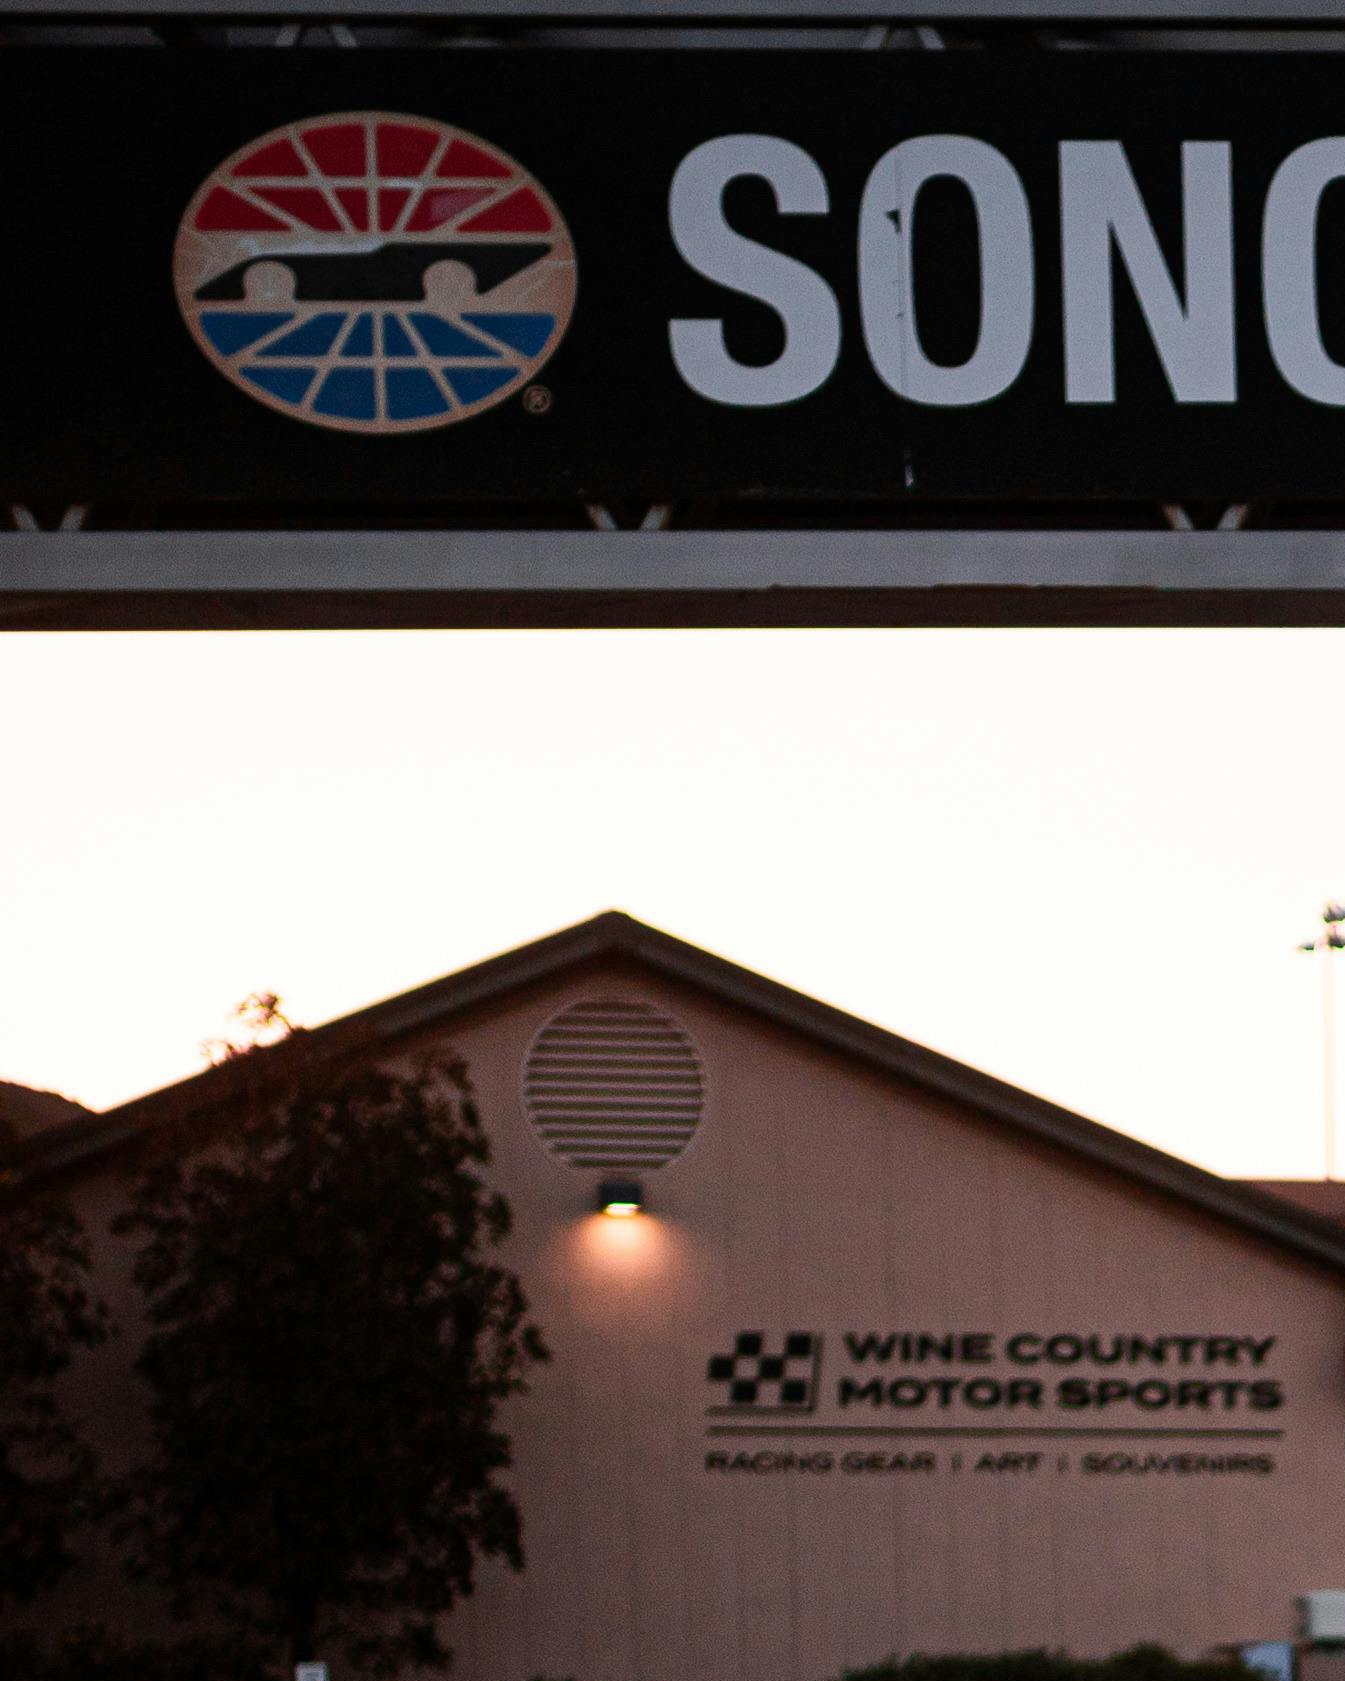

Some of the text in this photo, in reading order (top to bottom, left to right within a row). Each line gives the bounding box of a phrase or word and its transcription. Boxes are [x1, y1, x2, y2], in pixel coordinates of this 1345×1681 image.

[842, 1331, 1277, 1367] WINE COUNTRY
[838, 1376, 1284, 1411] MOTOR SPORTS
[705, 1451, 833, 1474] RACING
[841, 1451, 936, 1473] GEAR
[974, 1451, 1042, 1473] ART
